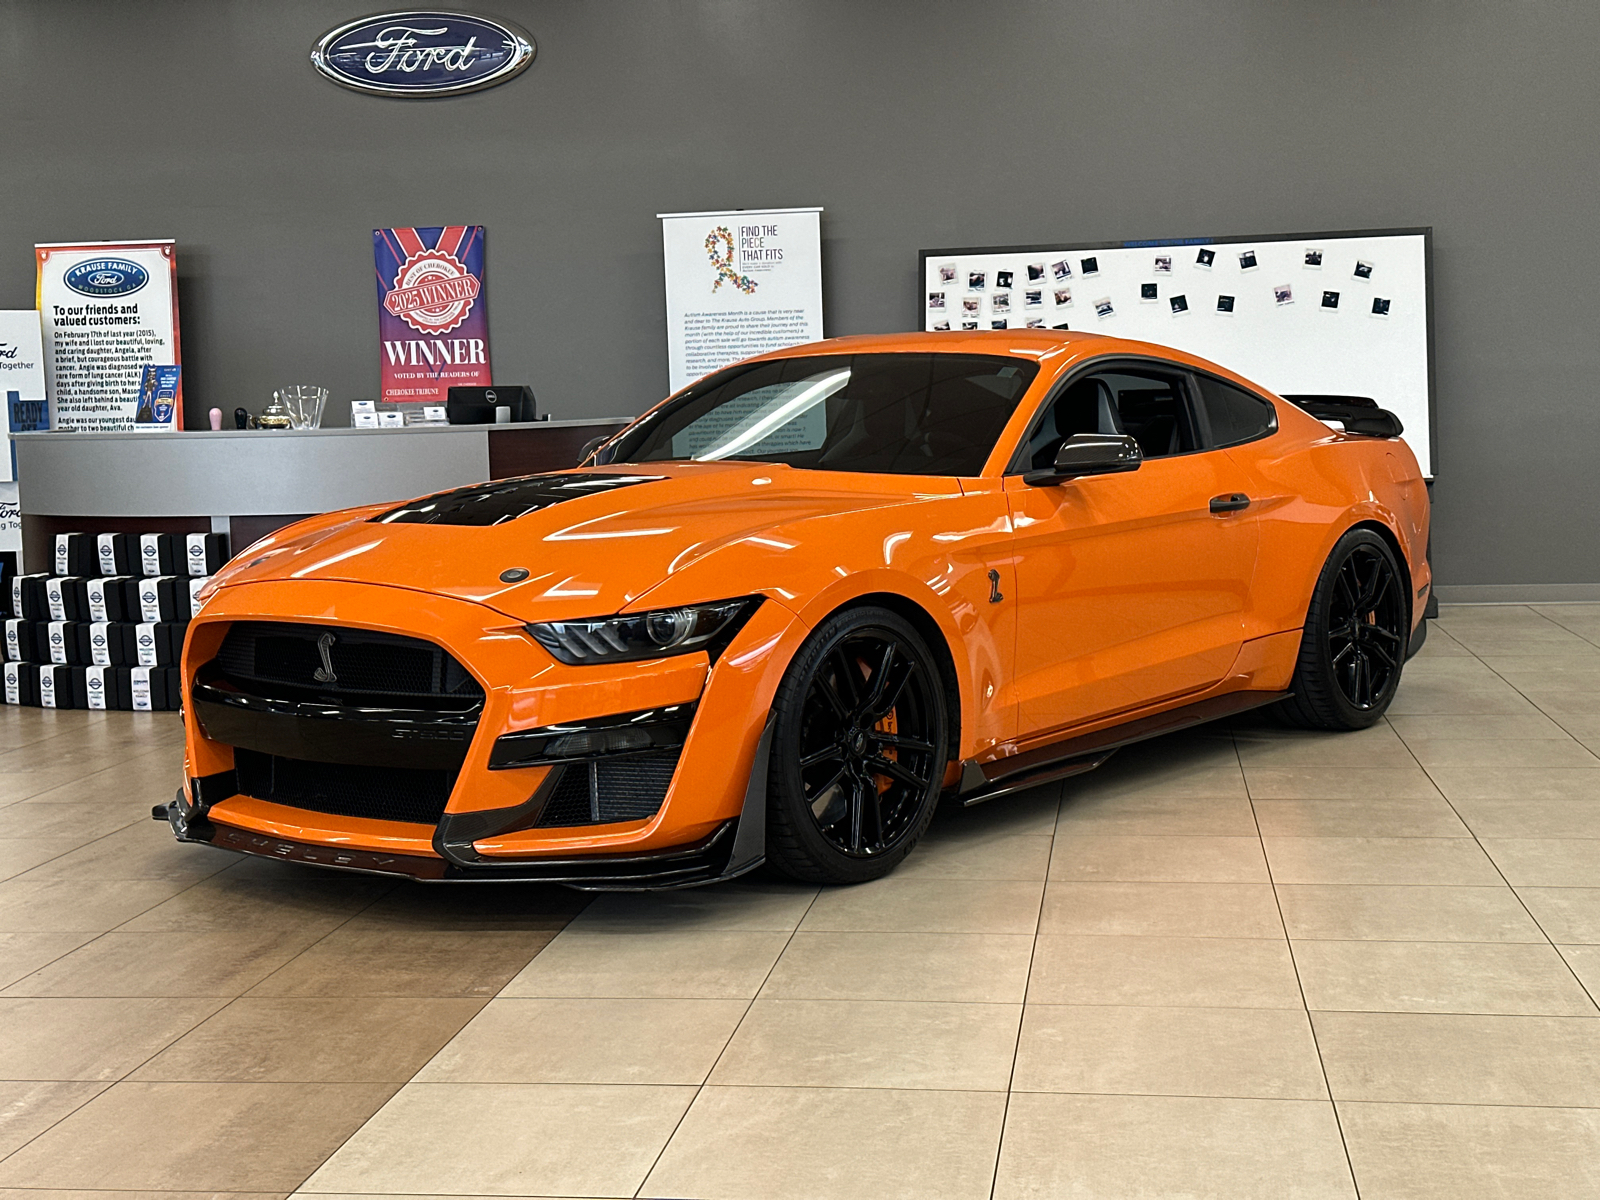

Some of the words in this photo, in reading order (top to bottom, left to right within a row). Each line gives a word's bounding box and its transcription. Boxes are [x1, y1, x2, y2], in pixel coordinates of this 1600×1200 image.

[365, 26, 476, 74] Ford
[741, 225, 760, 237] FIND
[762, 225, 778, 236] THE
[742, 237, 764, 248] PIECE
[742, 250, 763, 261] THAT
[766, 248, 784, 260] FITS
[74, 262, 106, 276] KRAUSE
[108, 262, 138, 275] FAMILY
[406, 272, 416, 286] BEST
[424, 263, 455, 276] CHEROKEE
[94, 274, 118, 284] Ford
[392, 290, 420, 311] 2025
[420, 280, 473, 305] WINNER
[54, 306, 65, 316] To
[68, 307, 83, 315] our
[86, 304, 118, 315] friends
[120, 303, 138, 314] and
[54, 316, 86, 326] valued
[88, 316, 140, 326] customers:
[64, 331, 89, 340] February
[384, 338, 486, 366] WINNER
[108, 363, 138, 371] diagnosed
[92, 372, 104, 380] lung
[56, 380, 70, 388] days
[56, 388, 73, 396] child,
[14, 402, 42, 423] READY
[82, 404, 109, 412] daughter,
